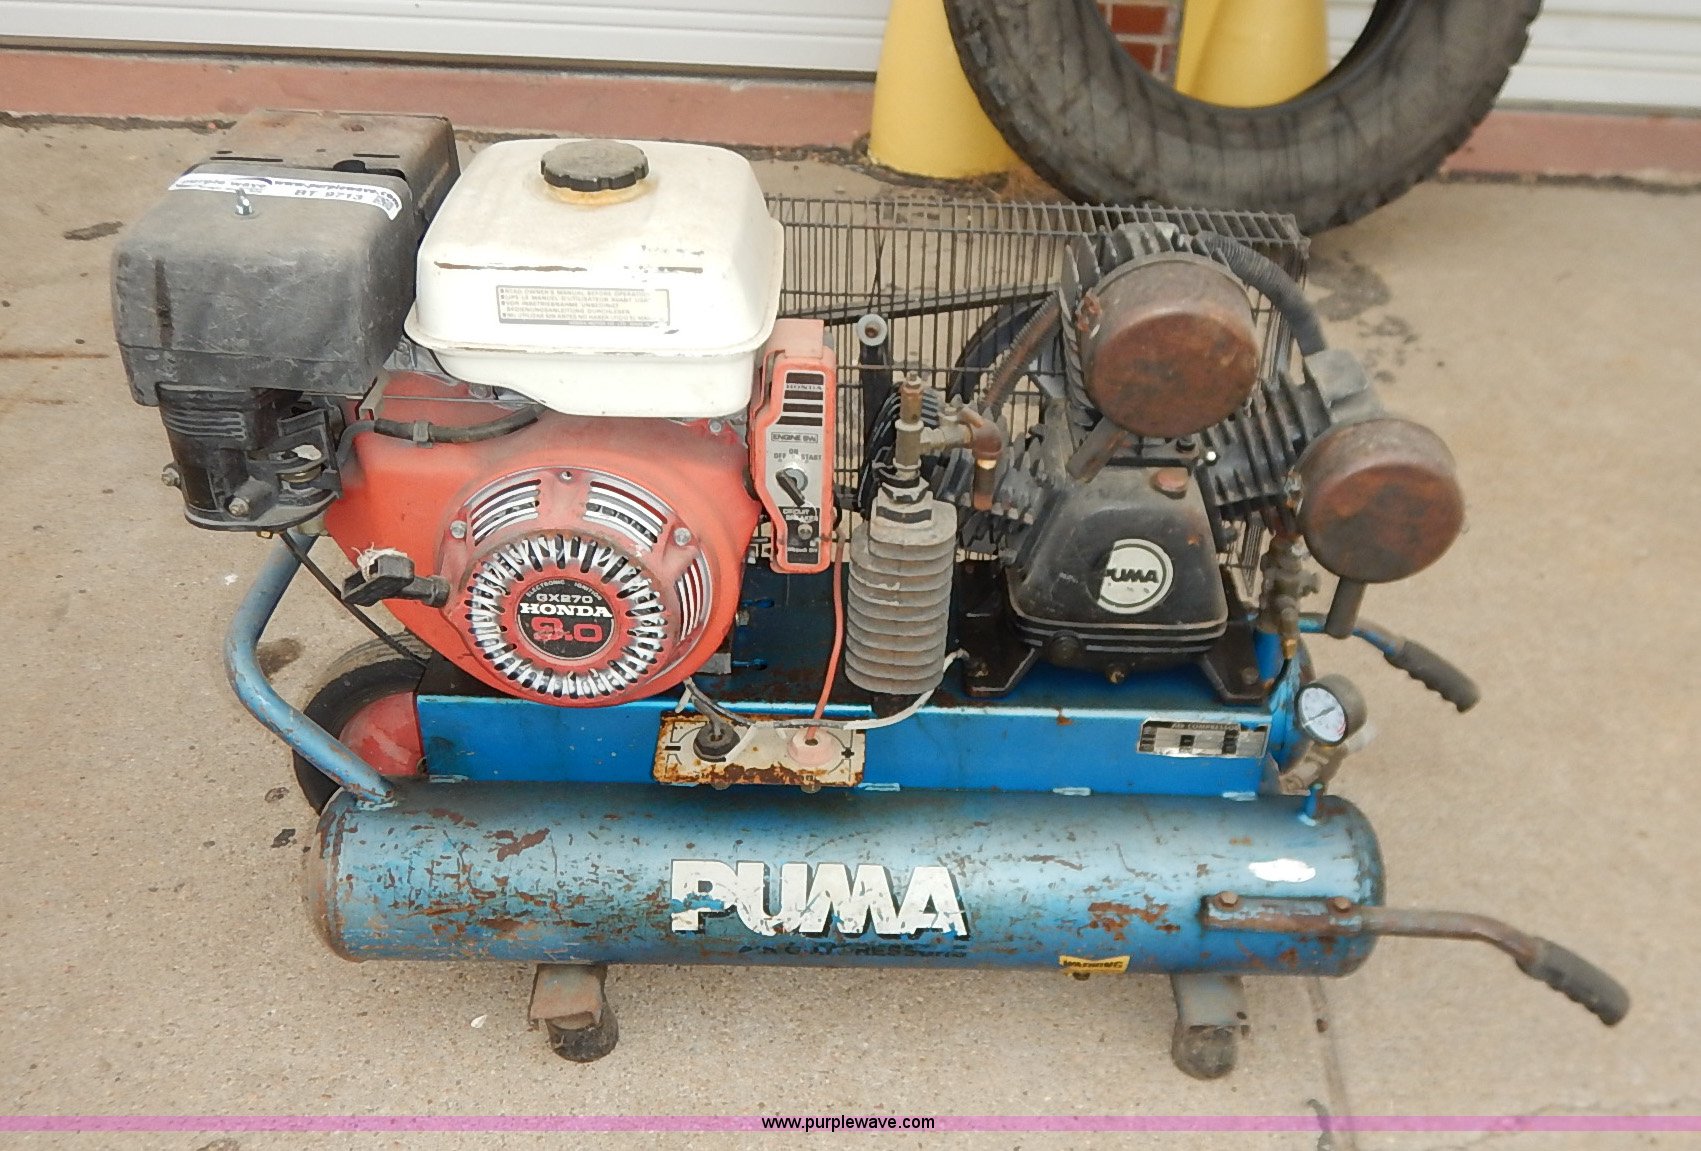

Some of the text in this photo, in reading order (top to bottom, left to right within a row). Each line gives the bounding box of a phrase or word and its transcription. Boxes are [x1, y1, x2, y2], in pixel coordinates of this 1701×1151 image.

[1106, 568, 1159, 583] UMA
[526, 579, 602, 600] ELECTRONIC IGNITION
[536, 593, 594, 604] GX270
[519, 602, 613, 618] HONDA
[532, 617, 602, 642] 9.0
[670, 859, 970, 939] PUMA
